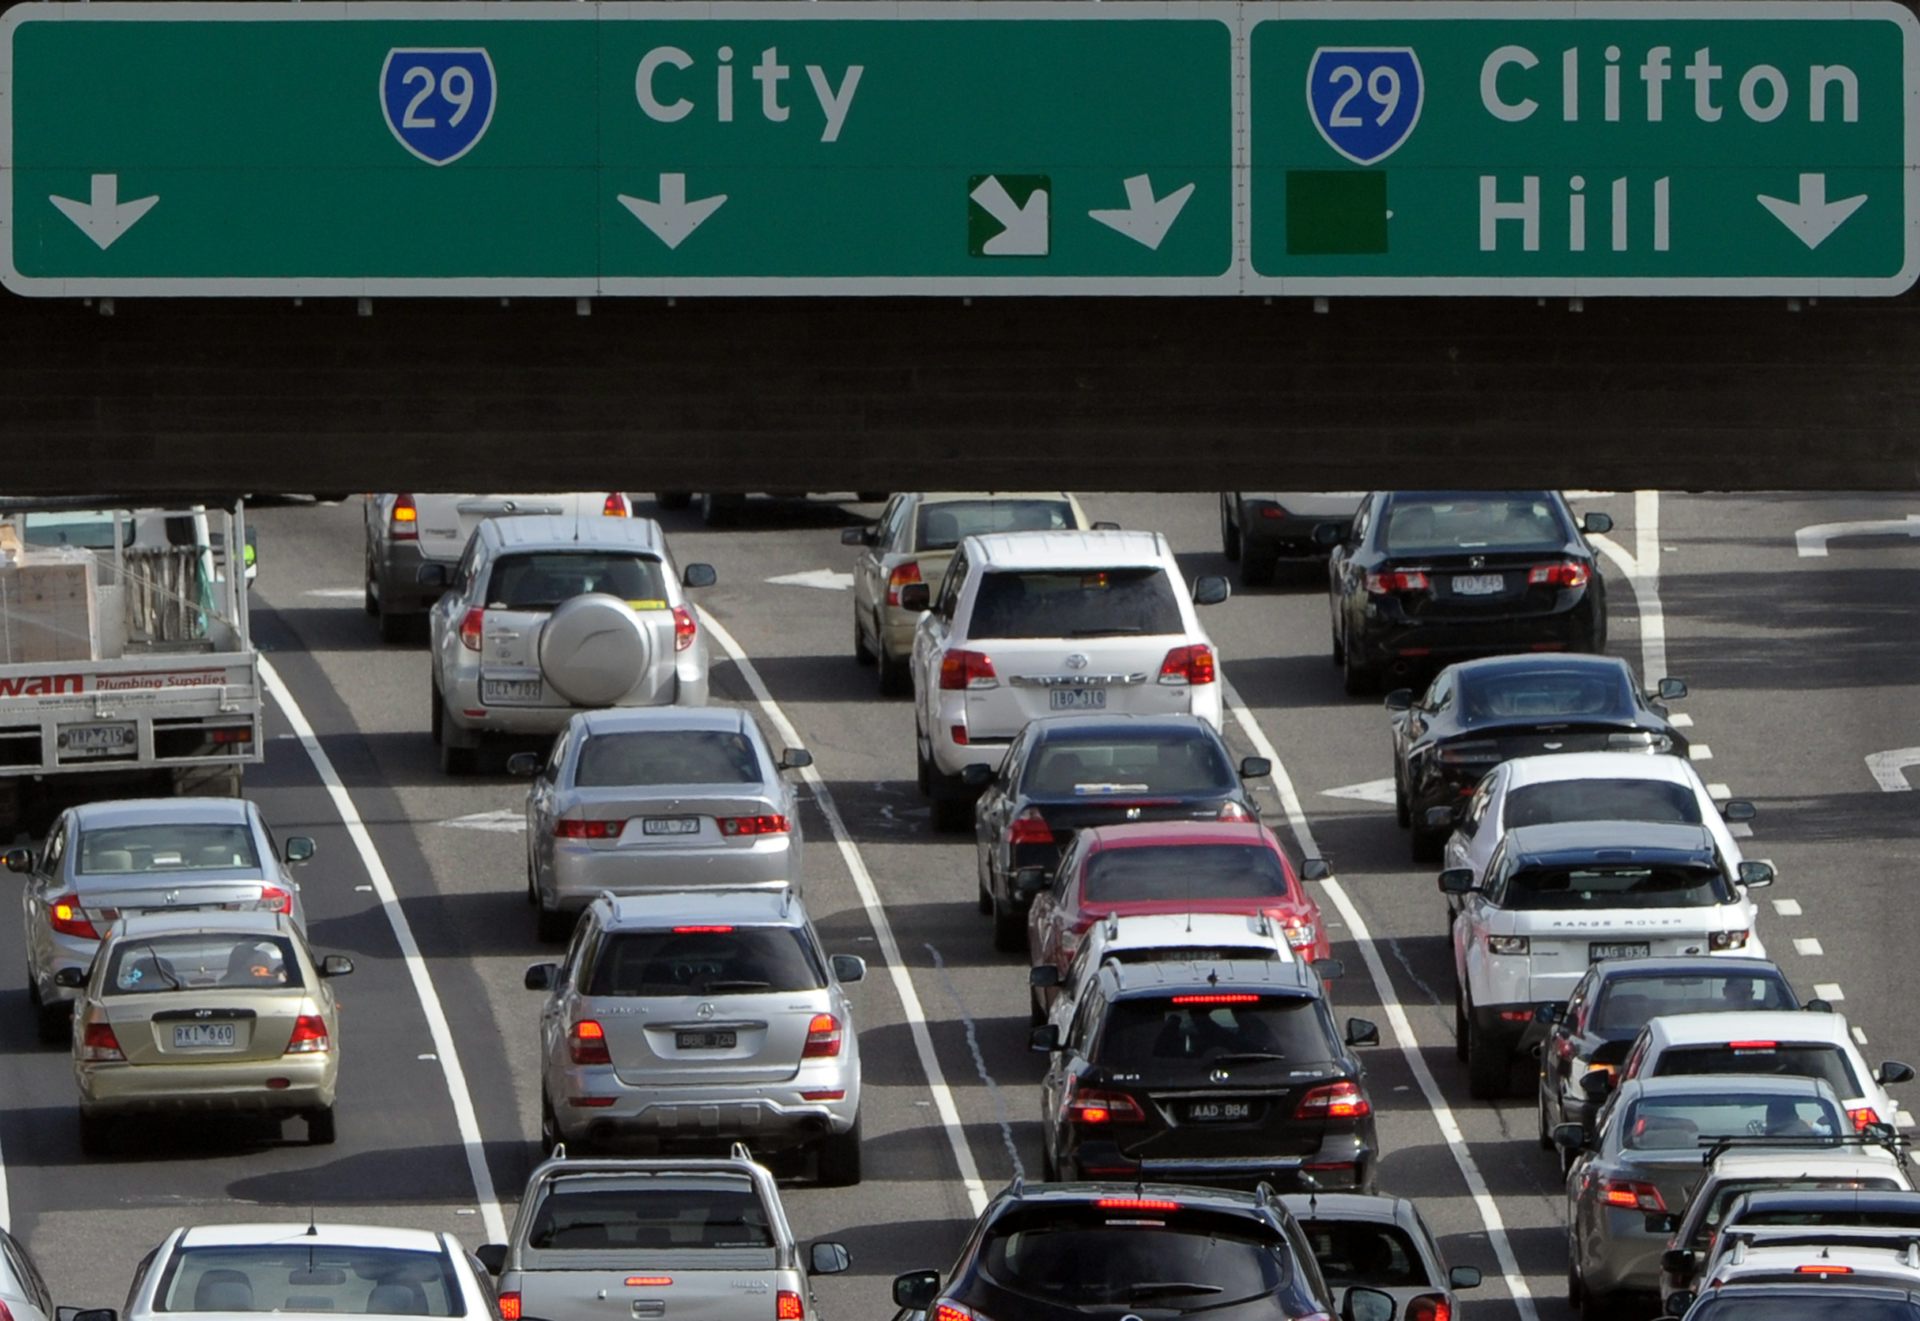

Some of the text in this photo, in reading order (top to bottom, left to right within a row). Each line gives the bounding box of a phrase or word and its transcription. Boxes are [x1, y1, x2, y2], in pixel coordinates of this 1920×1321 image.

[402, 66, 474, 128] 29
[635, 46, 864, 142] City
[1329, 65, 1401, 127] 29
[1480, 45, 1859, 123] Clifton
[1480, 175, 1670, 251] Hill
[95, 674, 227, 690] Plumbing Supplies
